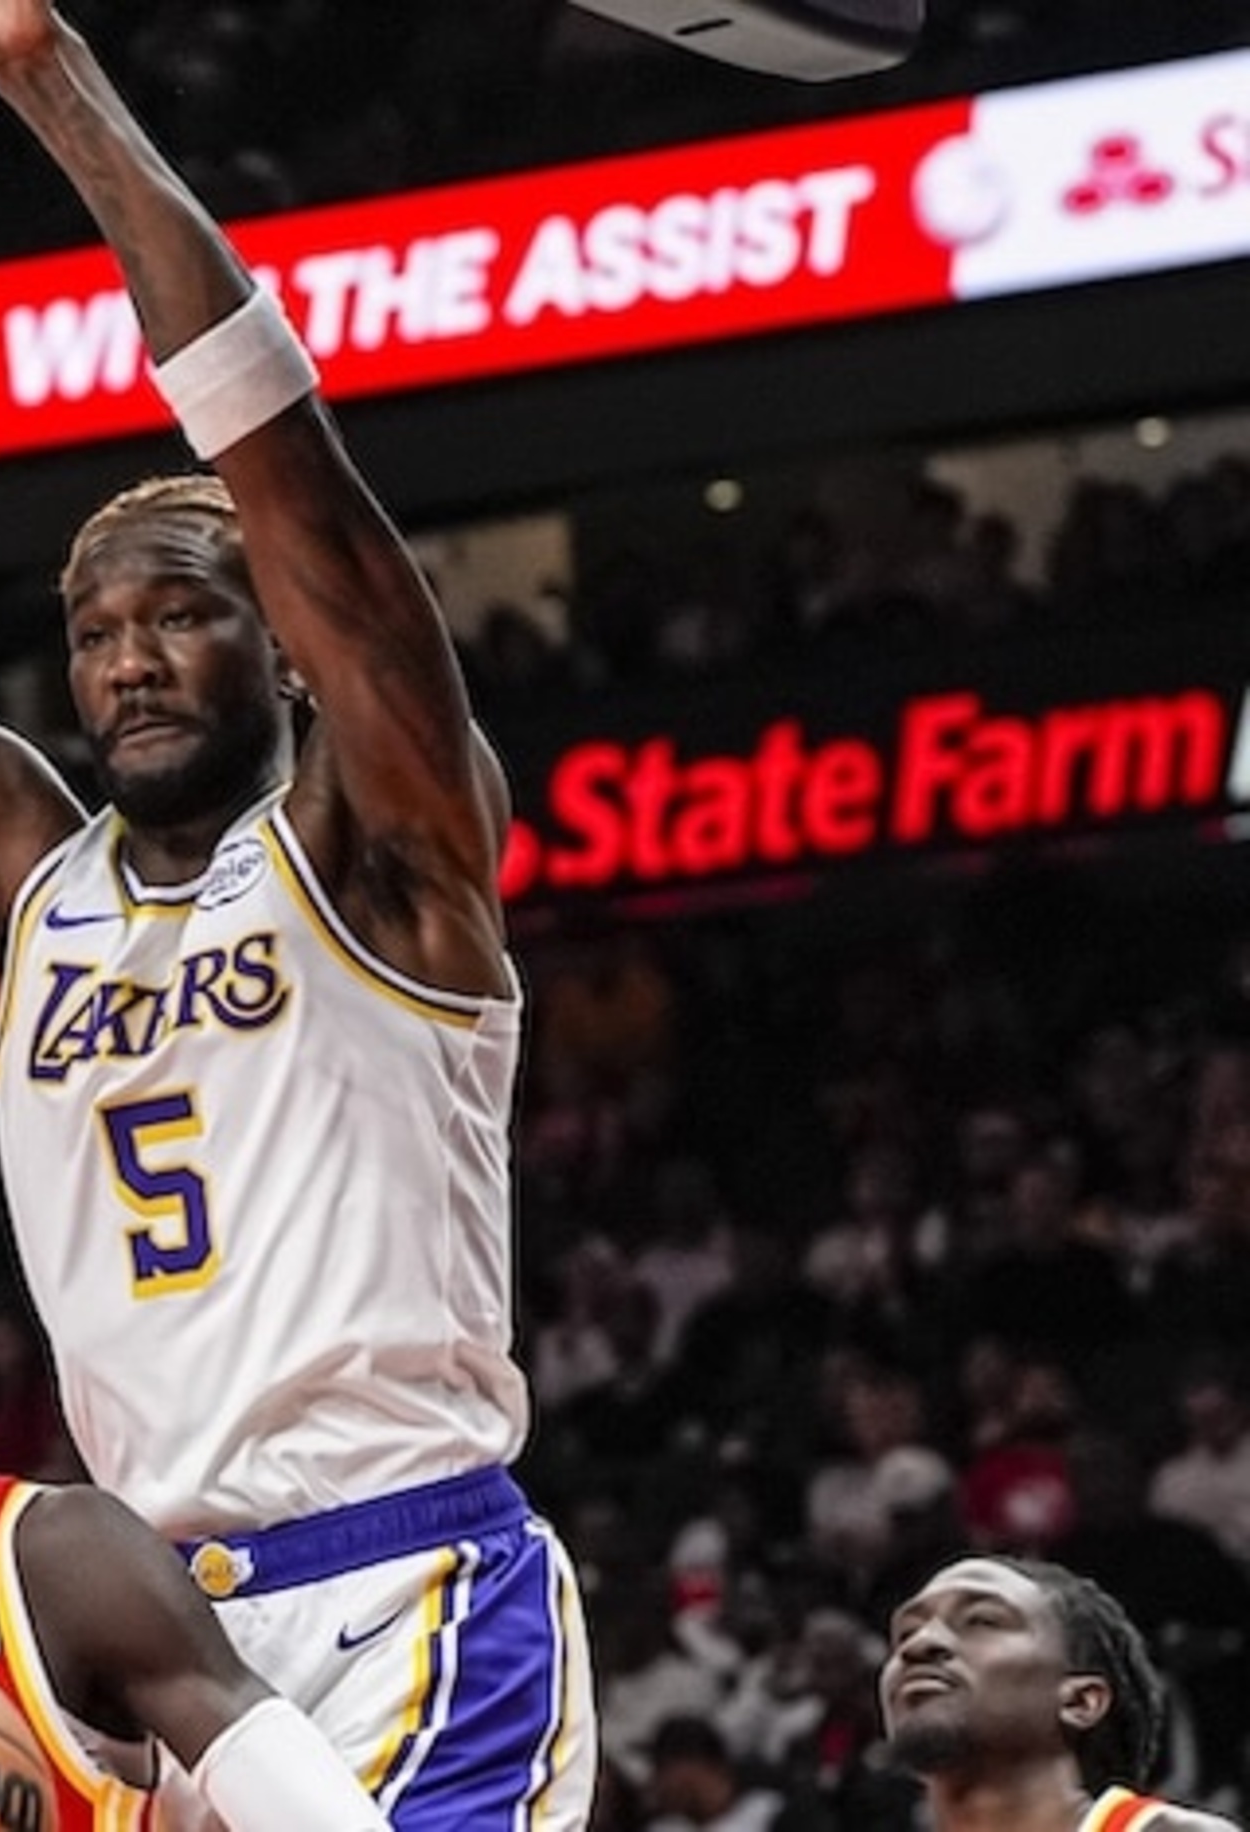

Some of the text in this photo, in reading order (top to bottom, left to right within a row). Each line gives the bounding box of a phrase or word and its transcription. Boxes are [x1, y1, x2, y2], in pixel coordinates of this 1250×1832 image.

[293, 231, 499, 358] THE
[504, 165, 875, 326] ASSIST
[548, 691, 1226, 886] State Farm
[95, 1087, 222, 1300] 5
